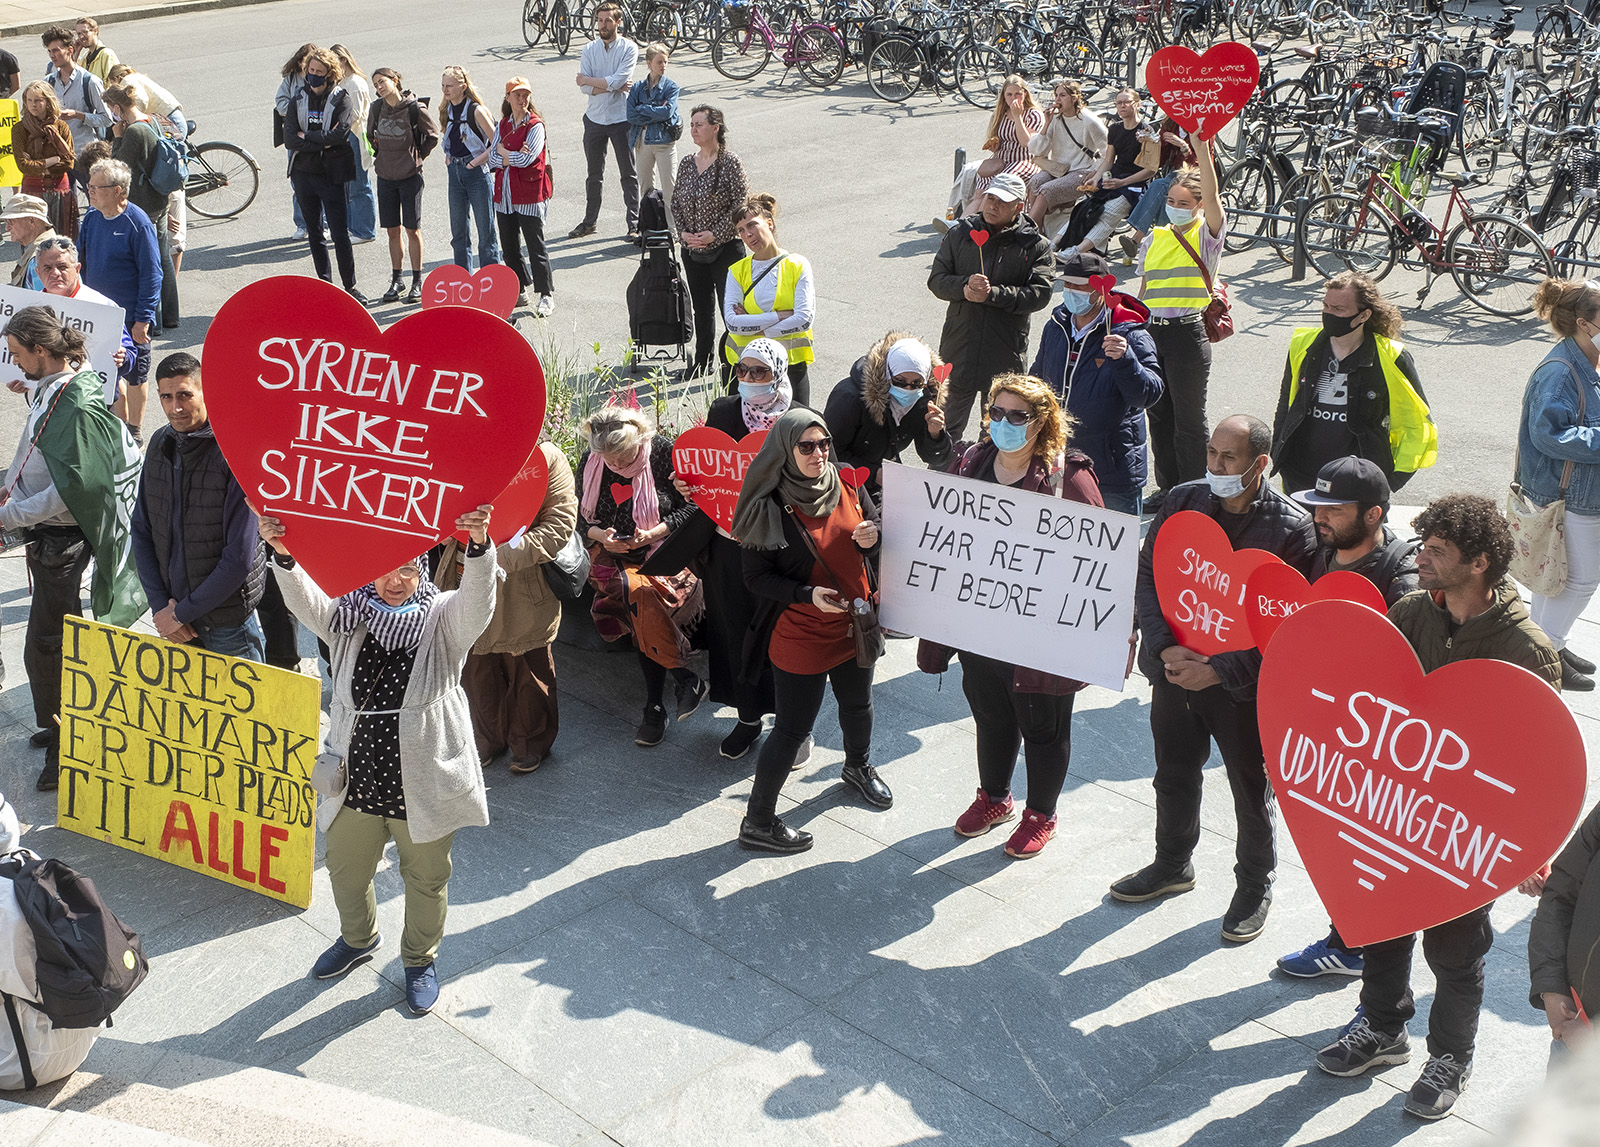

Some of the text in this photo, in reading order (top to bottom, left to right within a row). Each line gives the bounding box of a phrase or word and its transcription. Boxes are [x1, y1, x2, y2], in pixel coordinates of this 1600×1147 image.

[1160, 59, 1245, 76] Hvor er vores
[60, 311, 94, 334] Iran
[434, 277, 493, 303] STOP
[257, 337, 488, 418] SYRIEN ER
[295, 402, 429, 459] IKKE
[675, 448, 758, 481] HUMA
[257, 449, 464, 531] SIKKERT
[924, 481, 1125, 551] VORES BØRN
[918, 521, 1112, 592] HAR RET TIL
[1177, 548, 1230, 596] SYRIA
[906, 560, 1116, 632] ET BEDRE LIV
[1175, 589, 1234, 642] SAFE
[64, 619, 262, 713] I VORES
[64, 667, 315, 781] DANMARK
[1336, 691, 1470, 783] STOP
[63, 713, 316, 828] ER DER PLADS
[60, 764, 289, 895] TIL ALLE
[1280, 727, 1522, 890] UDVISNINGERNE
